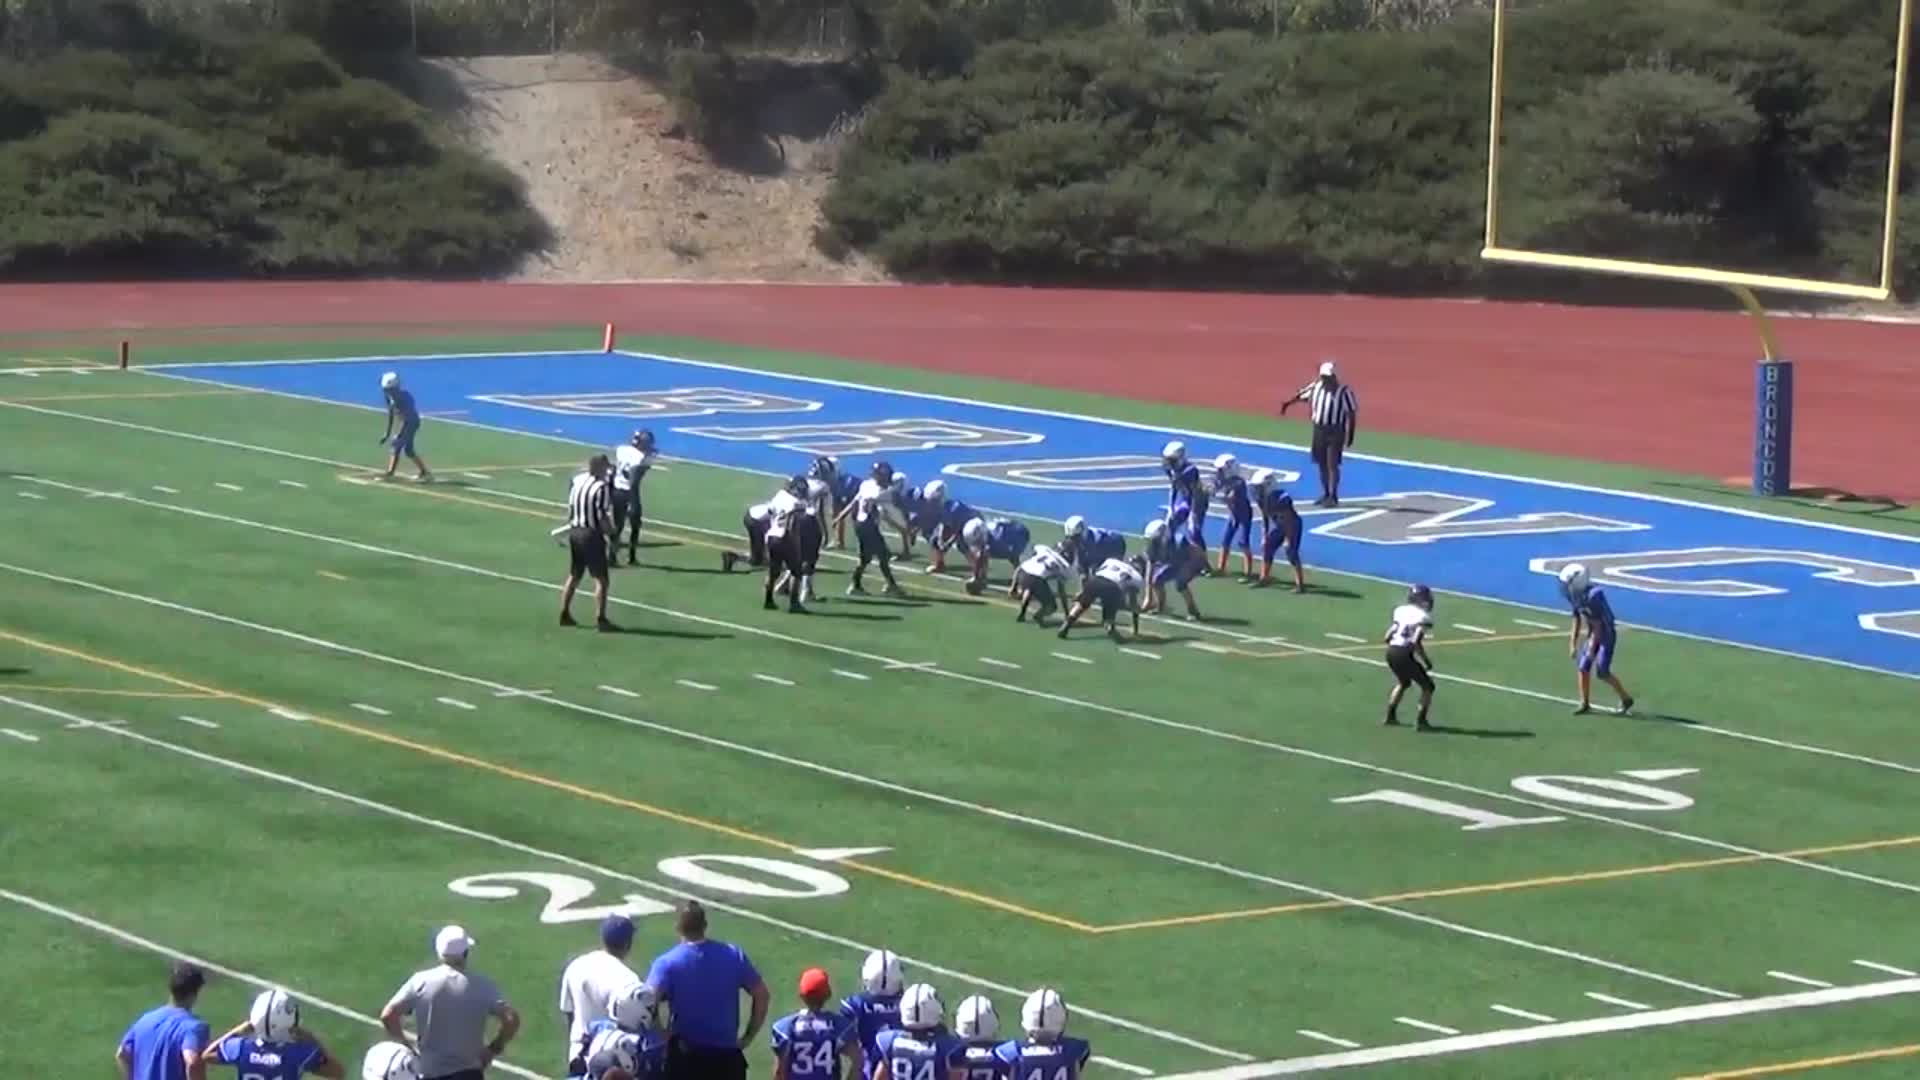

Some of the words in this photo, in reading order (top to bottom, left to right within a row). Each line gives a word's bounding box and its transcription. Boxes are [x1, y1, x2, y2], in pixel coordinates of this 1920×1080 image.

[1763, 365, 1778, 496] BRONCOS
[465, 387, 1920, 638] BRONC
[1330, 775, 1696, 831] 10
[447, 854, 850, 924] 20
[791, 1040, 835, 1075] 34
